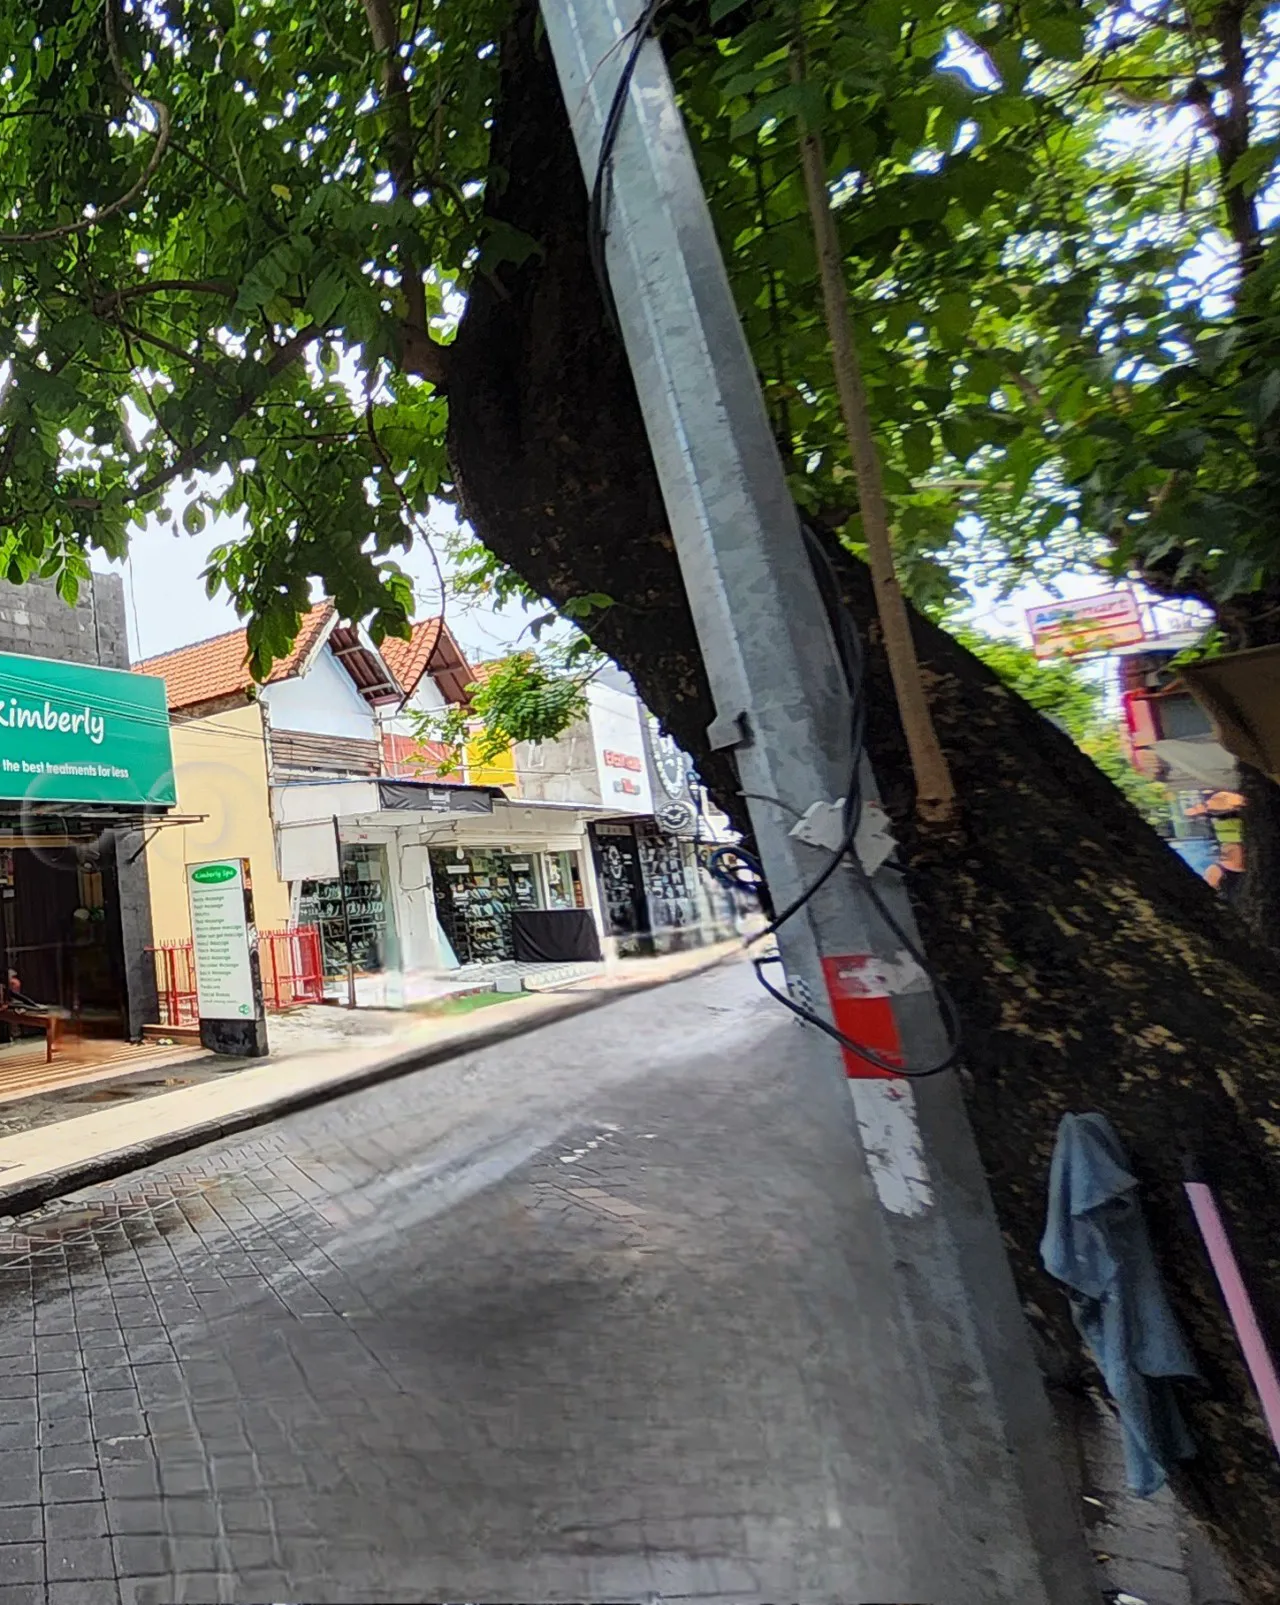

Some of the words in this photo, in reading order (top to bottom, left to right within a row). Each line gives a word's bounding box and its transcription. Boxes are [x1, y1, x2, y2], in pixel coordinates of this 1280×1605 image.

[3, 759, 20, 772] the
[22, 760, 45, 774] best
[46, 762, 98, 777] treatments
[98, 765, 112, 777] for
[112, 766, 130, 778] less
